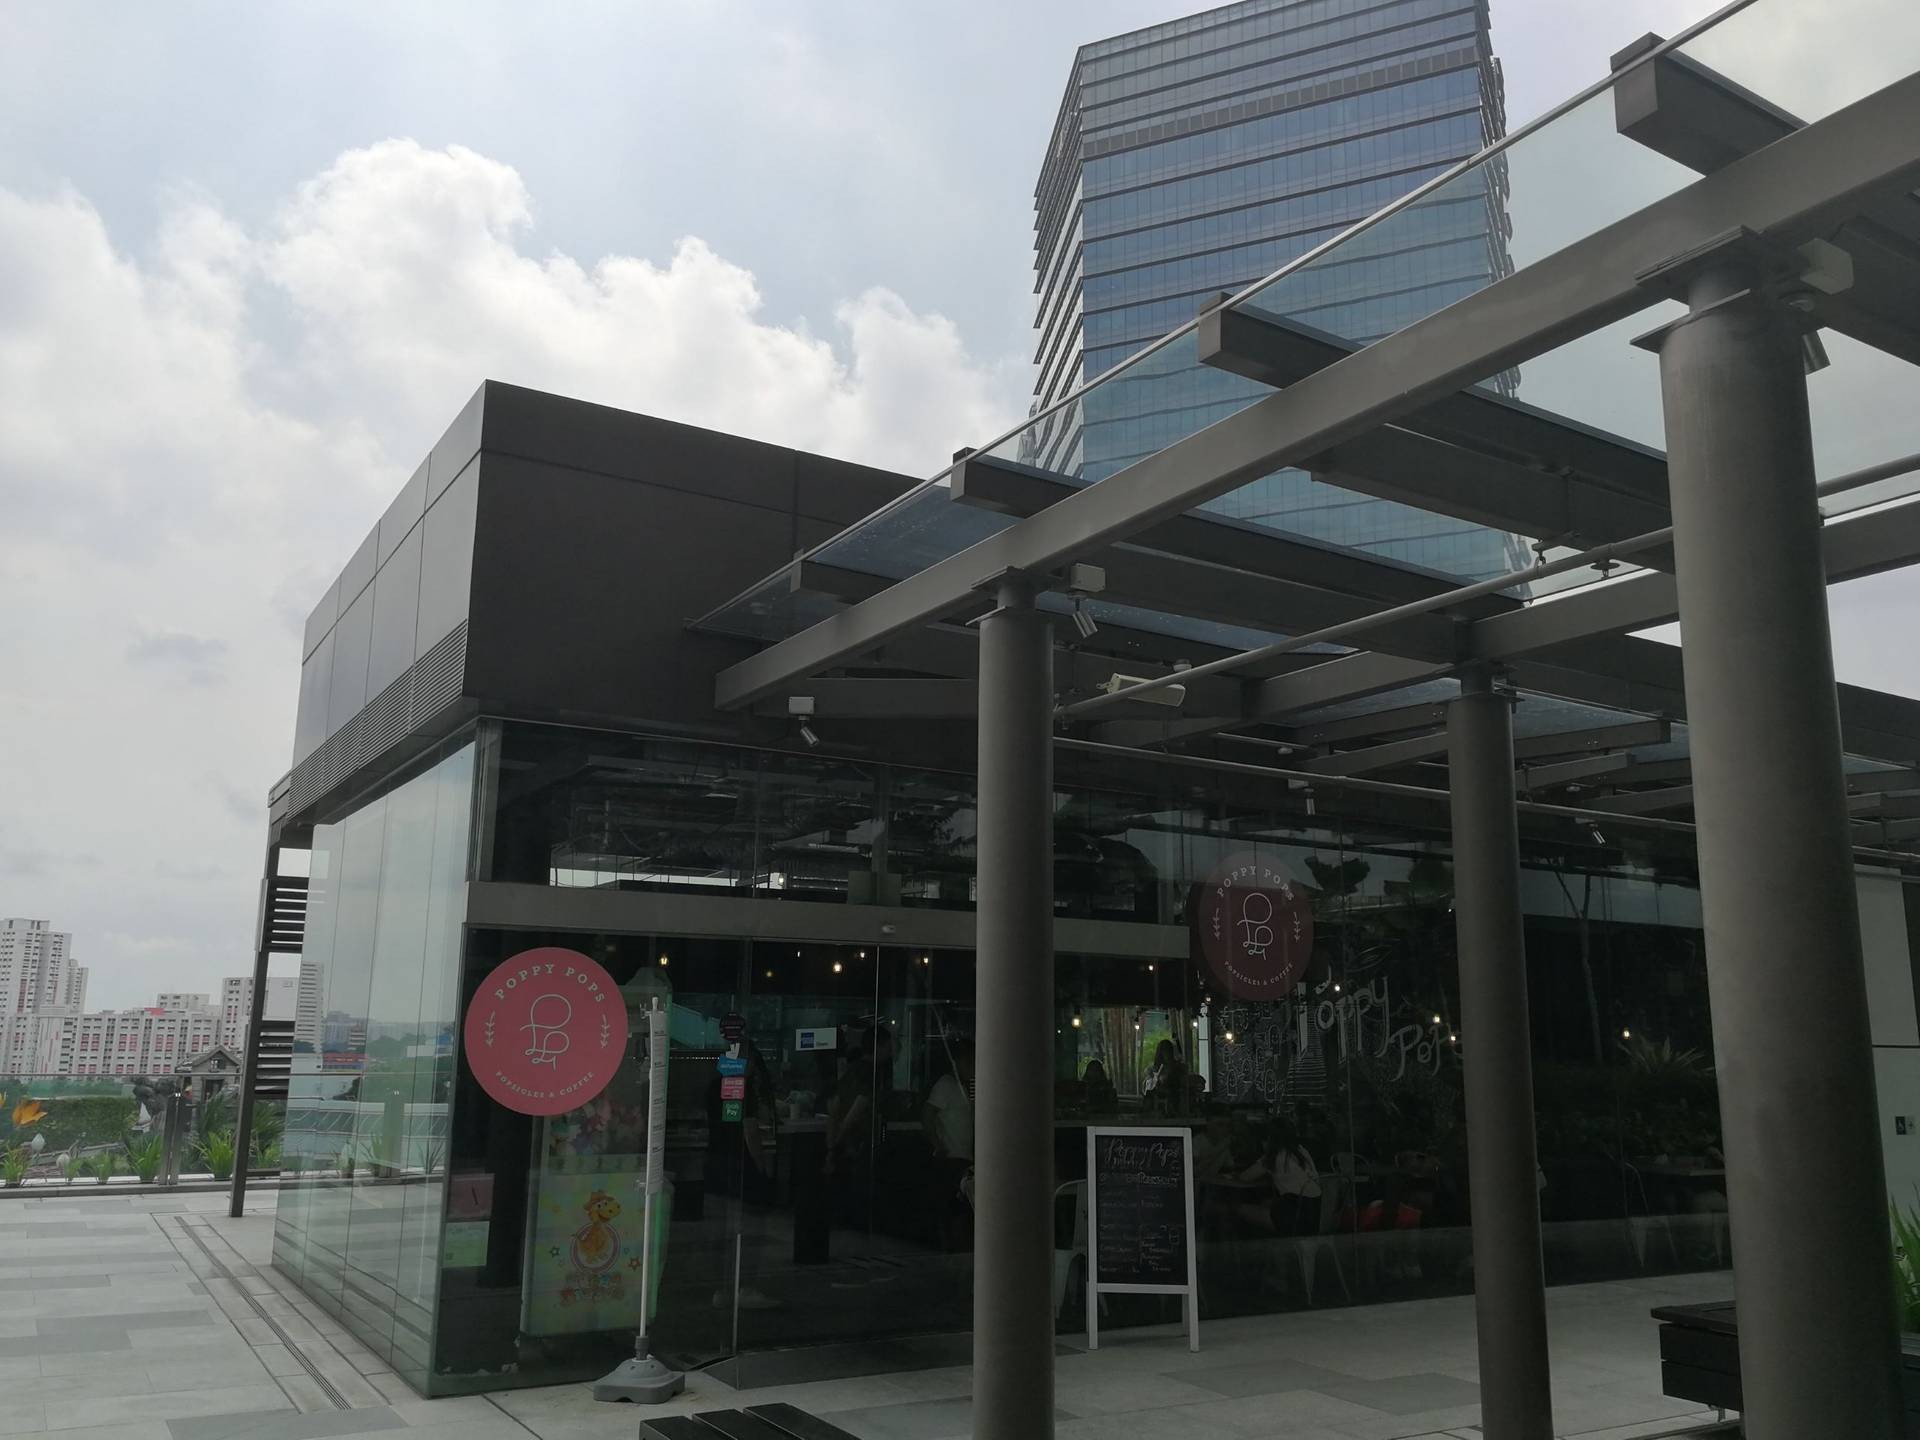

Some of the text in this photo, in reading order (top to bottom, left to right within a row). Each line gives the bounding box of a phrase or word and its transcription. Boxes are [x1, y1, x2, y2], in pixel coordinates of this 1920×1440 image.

[1217, 865, 1295, 901] POPPY POPS
[495, 963, 605, 1003] POPPY POPS
